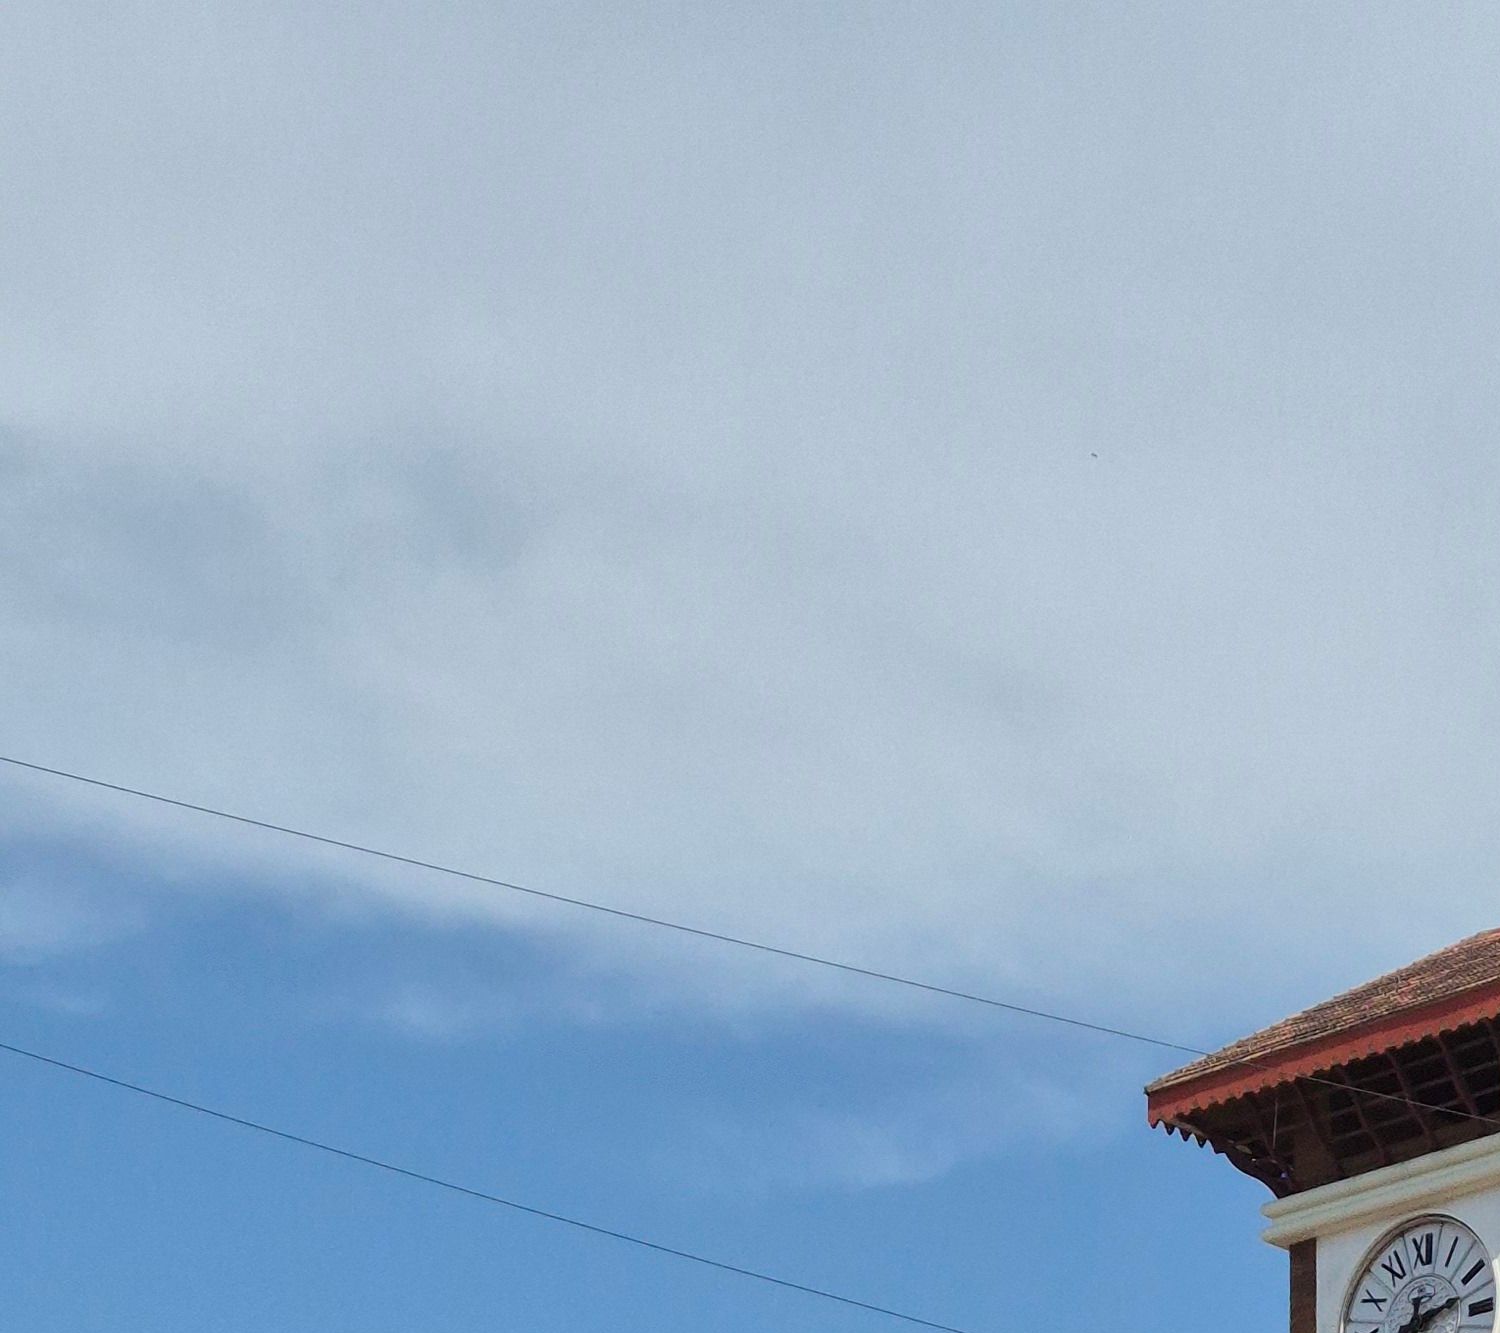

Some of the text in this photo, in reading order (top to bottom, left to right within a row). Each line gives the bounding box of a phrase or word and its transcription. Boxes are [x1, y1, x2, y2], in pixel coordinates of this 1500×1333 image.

[1412, 1232, 1433, 1270] XII
[1445, 1236, 1459, 1267] I
[1381, 1250, 1407, 1288] XI
[1361, 1289, 1388, 1312] X
